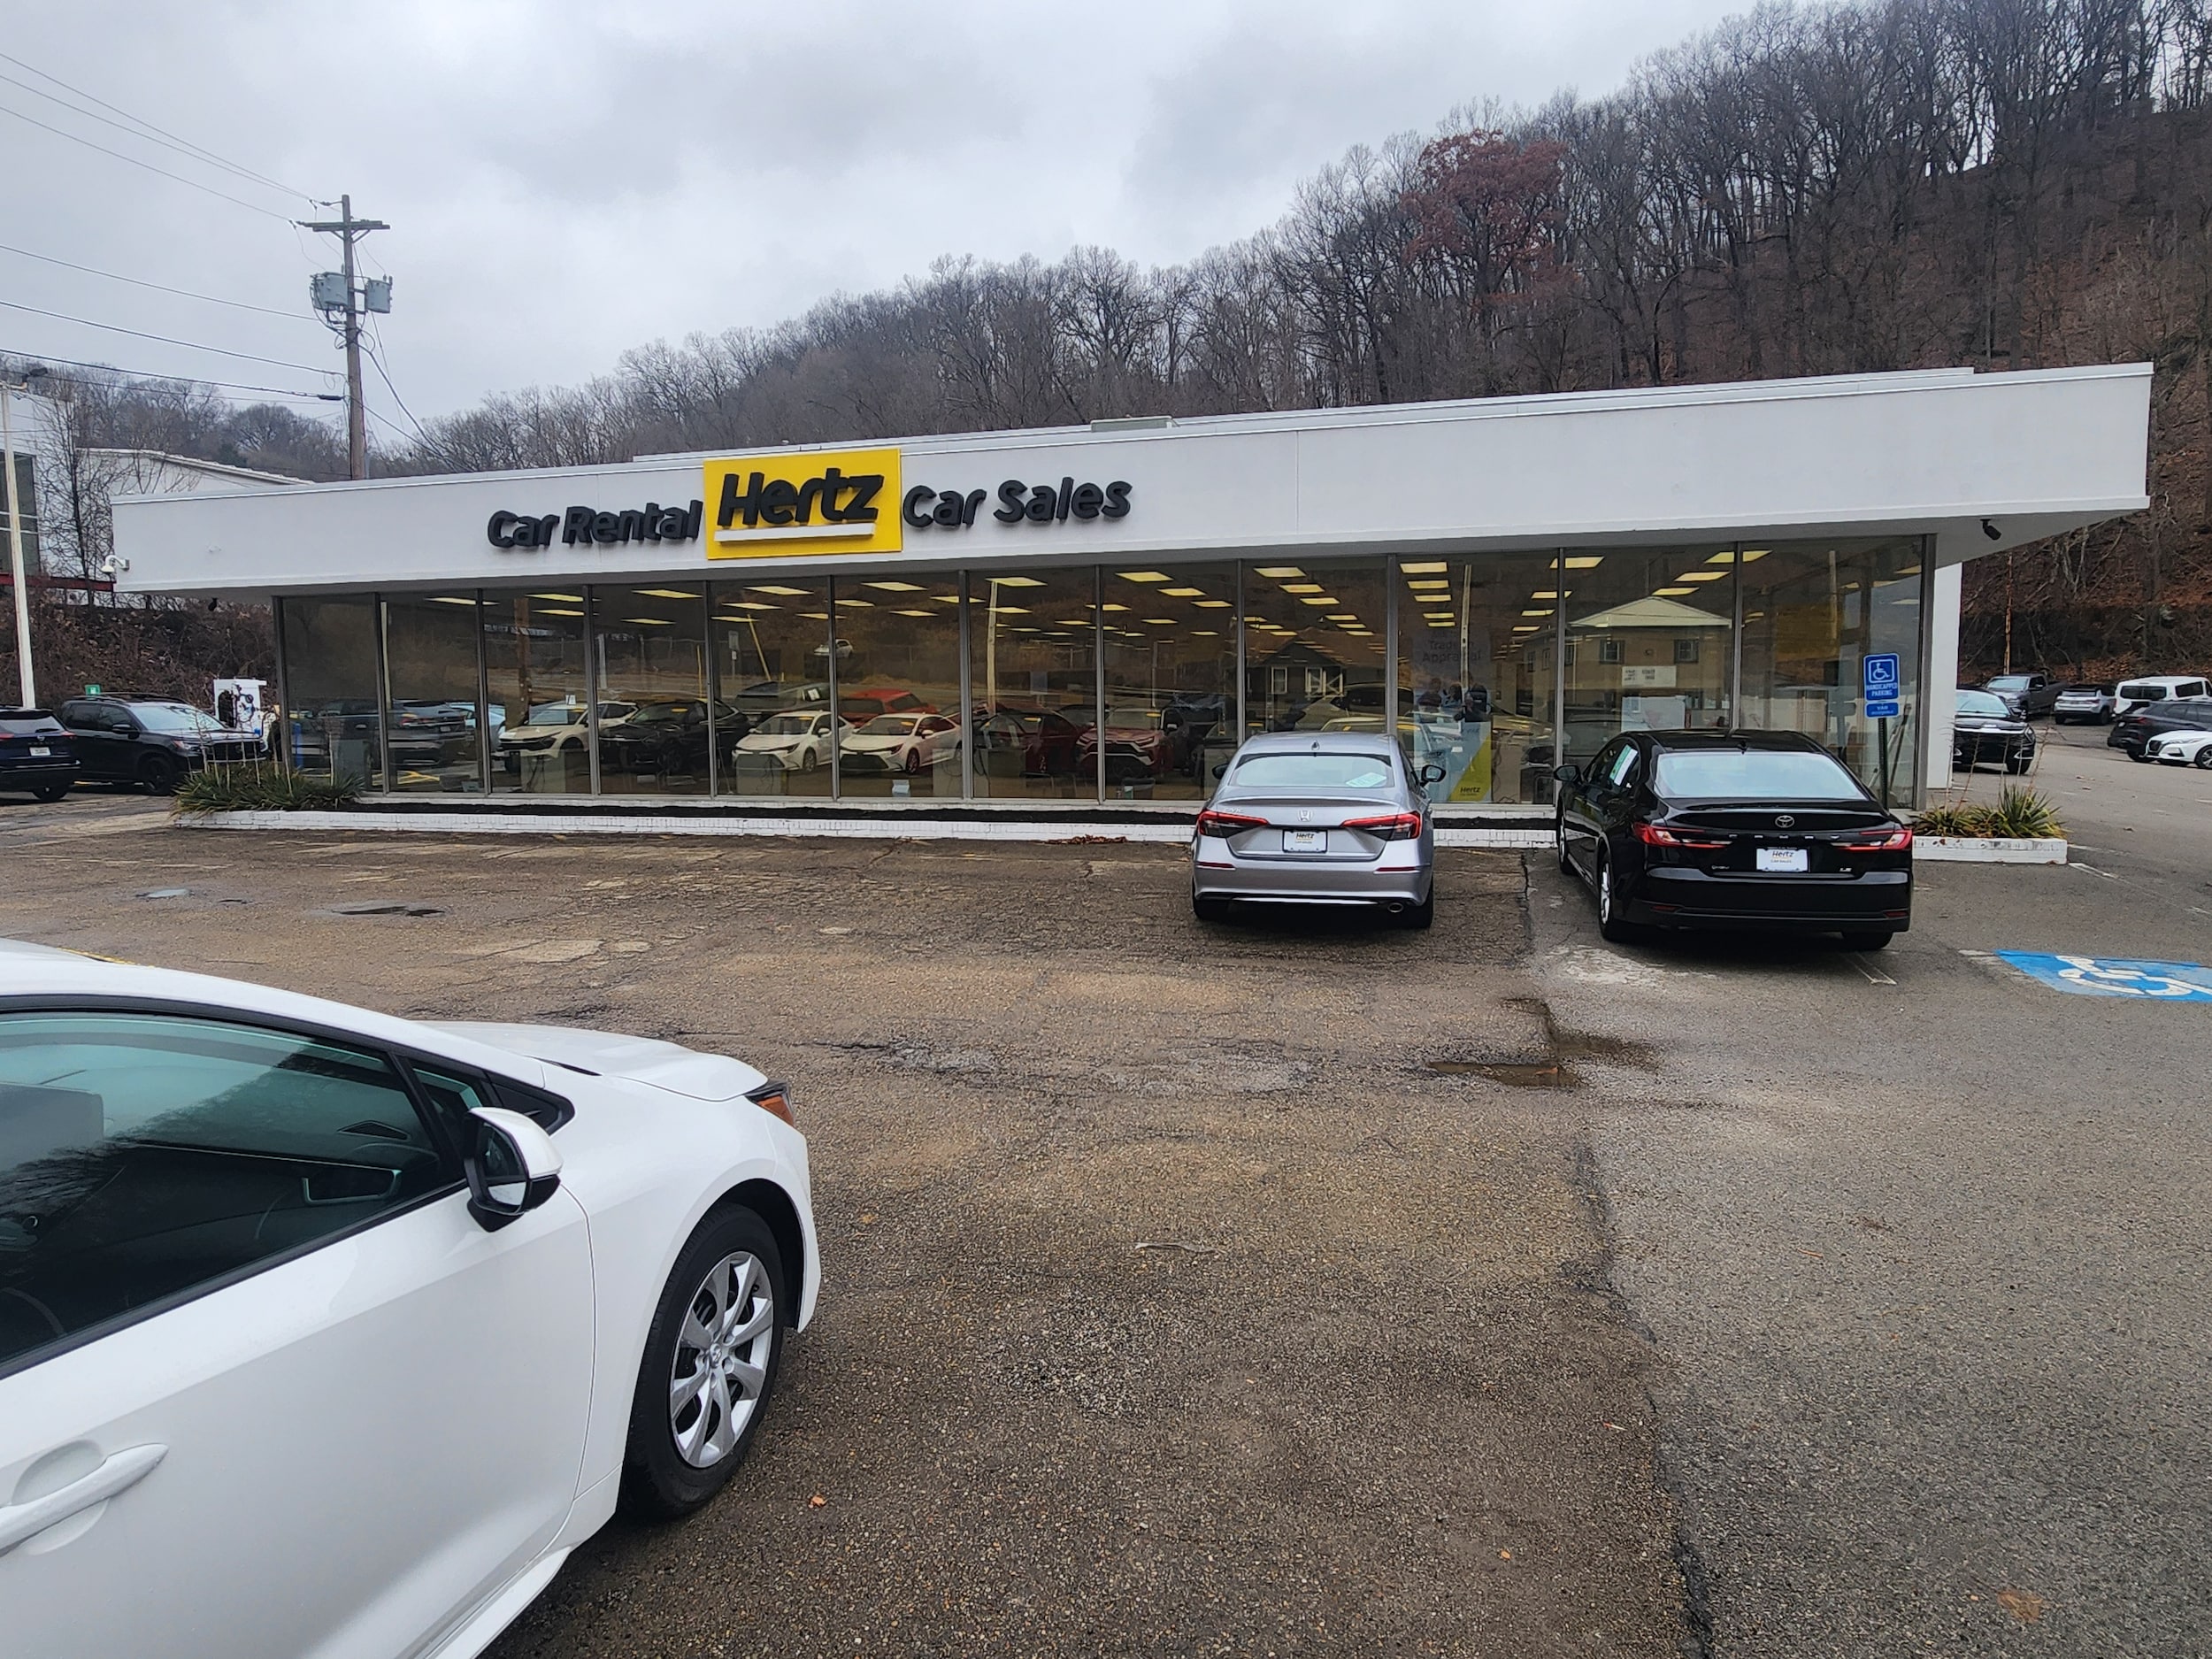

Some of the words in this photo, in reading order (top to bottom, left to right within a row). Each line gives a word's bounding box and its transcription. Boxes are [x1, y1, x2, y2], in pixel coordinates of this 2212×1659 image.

[717, 467, 884, 526] Hertz
[902, 484, 987, 528] Car
[993, 476, 1133, 523] Sales
[488, 510, 560, 548] Car
[562, 499, 703, 544] Rental
